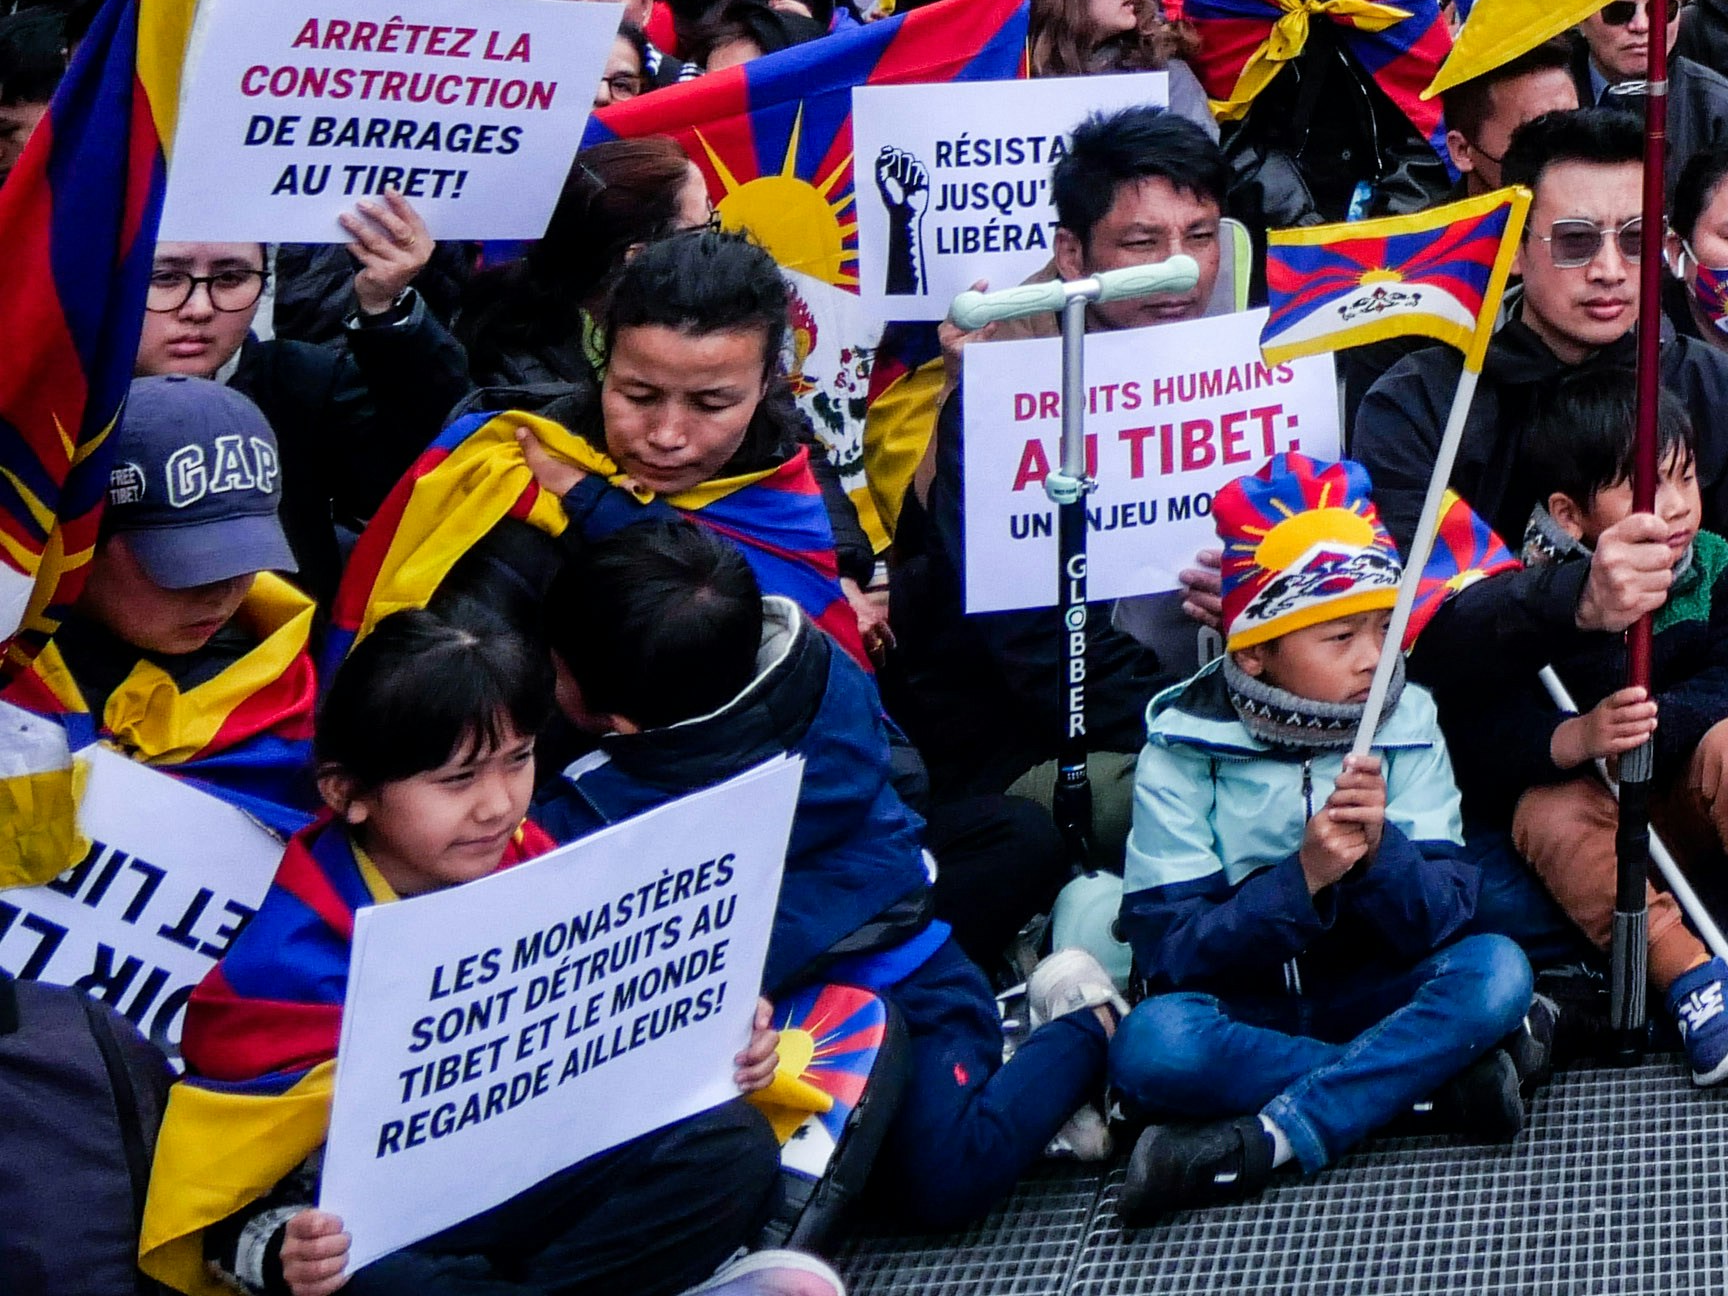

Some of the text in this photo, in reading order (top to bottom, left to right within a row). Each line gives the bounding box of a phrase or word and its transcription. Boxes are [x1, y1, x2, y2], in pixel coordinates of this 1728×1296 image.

[291, 15, 531, 63] ARRÊTEZ LA
[241, 65, 557, 110] CONSTRUCTION
[244, 115, 523, 154] DE BARRAGES
[935, 132, 1068, 168] RÉSISTA
[271, 164, 469, 199] AU TIBET!
[935, 179, 1052, 216] JUSQU'
[1014, 361, 1295, 421] DRITS HUMAINS
[1118, 404, 1300, 480] TIBET:
[109, 486, 139, 506] TIBET
[110, 466, 136, 486] FREE
[165, 434, 278, 508] GAP
[1010, 490, 1216, 540] UN NJEU MO
[1065, 554, 1086, 739] GLOBBER
[156, 886, 259, 960] ET
[429, 852, 736, 1002] LES MONASTÈRES
[408, 894, 737, 1054] SONT DÉTRUITS AU
[399, 939, 729, 1104] TIBET ET LE MONDE
[376, 981, 727, 1159] REGARDE AILLEURS!
